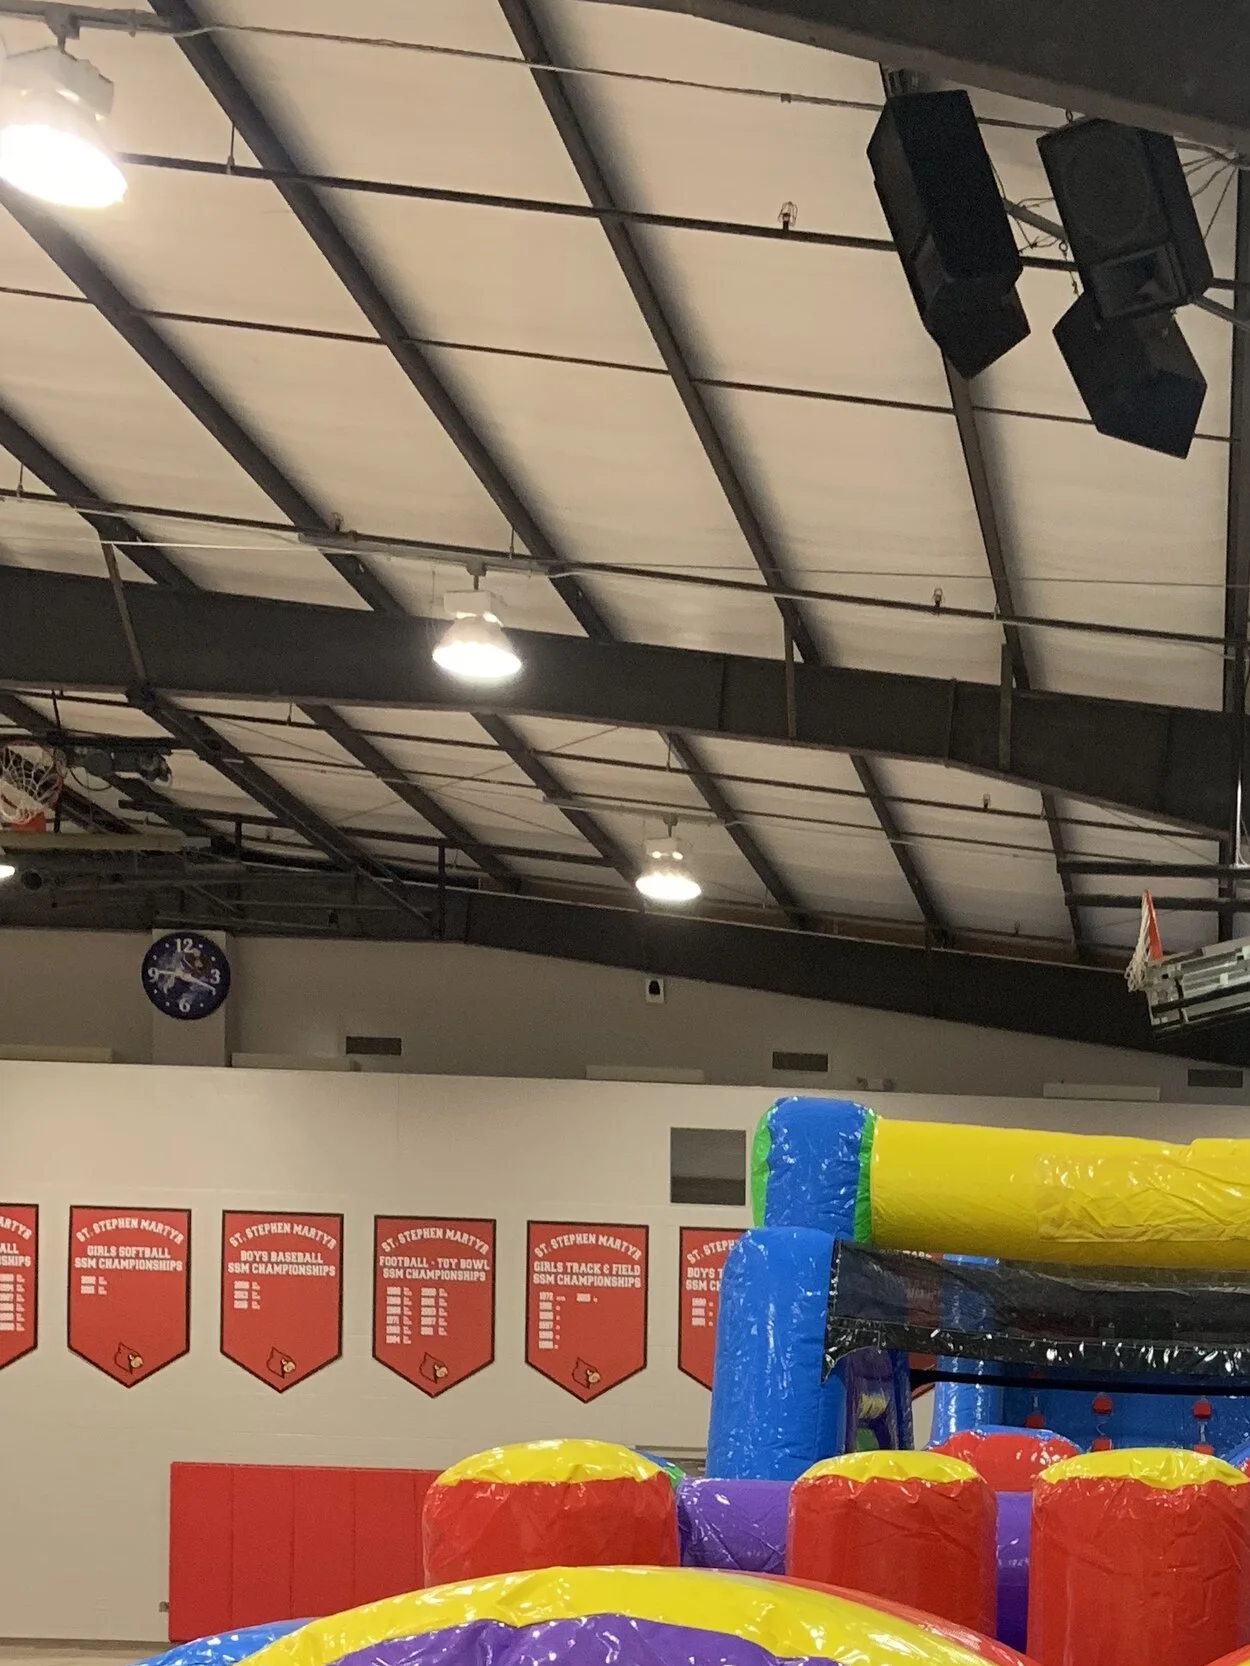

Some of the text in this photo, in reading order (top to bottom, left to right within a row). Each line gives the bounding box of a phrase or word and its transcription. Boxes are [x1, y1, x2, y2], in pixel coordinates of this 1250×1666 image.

[175, 938, 193, 953] 12
[148, 967, 159, 982] 9
[210, 968, 220, 984] 3
[179, 999, 190, 1012] 6
[0, 1216, 32, 1240] ARTYR
[76, 1217, 184, 1245] ST. STEPHEN MARTYR
[229, 1222, 337, 1250] ST. STEPHEN MARTYR
[381, 1227, 490, 1255] ST. STEPHEN MARTYR
[87, 1245, 171, 1259] GIRLS SOFTBALL
[534, 1233, 642, 1261] ST. STEPHEN MARTYR
[687, 1240, 736, 1264] ST. STEPH
[74, 1257, 183, 1272] SSM CHAMPIONSHIPS
[240, 1250, 324, 1264] BOYS BASEBALL
[379, 1255, 429, 1268] FOOTBALL
[437, 1257, 458, 1269] TOY
[460, 1258, 491, 1270] BOWL
[228, 1262, 336, 1277] SSM CHAMPIONSHIPS
[382, 1268, 486, 1282] SSM CHAMPIONSHIPS
[534, 1261, 641, 1276] GIRLS TRACK & FIELD
[687, 1267, 716, 1279] BOYS
[533, 1273, 641, 1288] SSM CHAMPIONSHIPS
[686, 1279, 708, 1291] SSM
